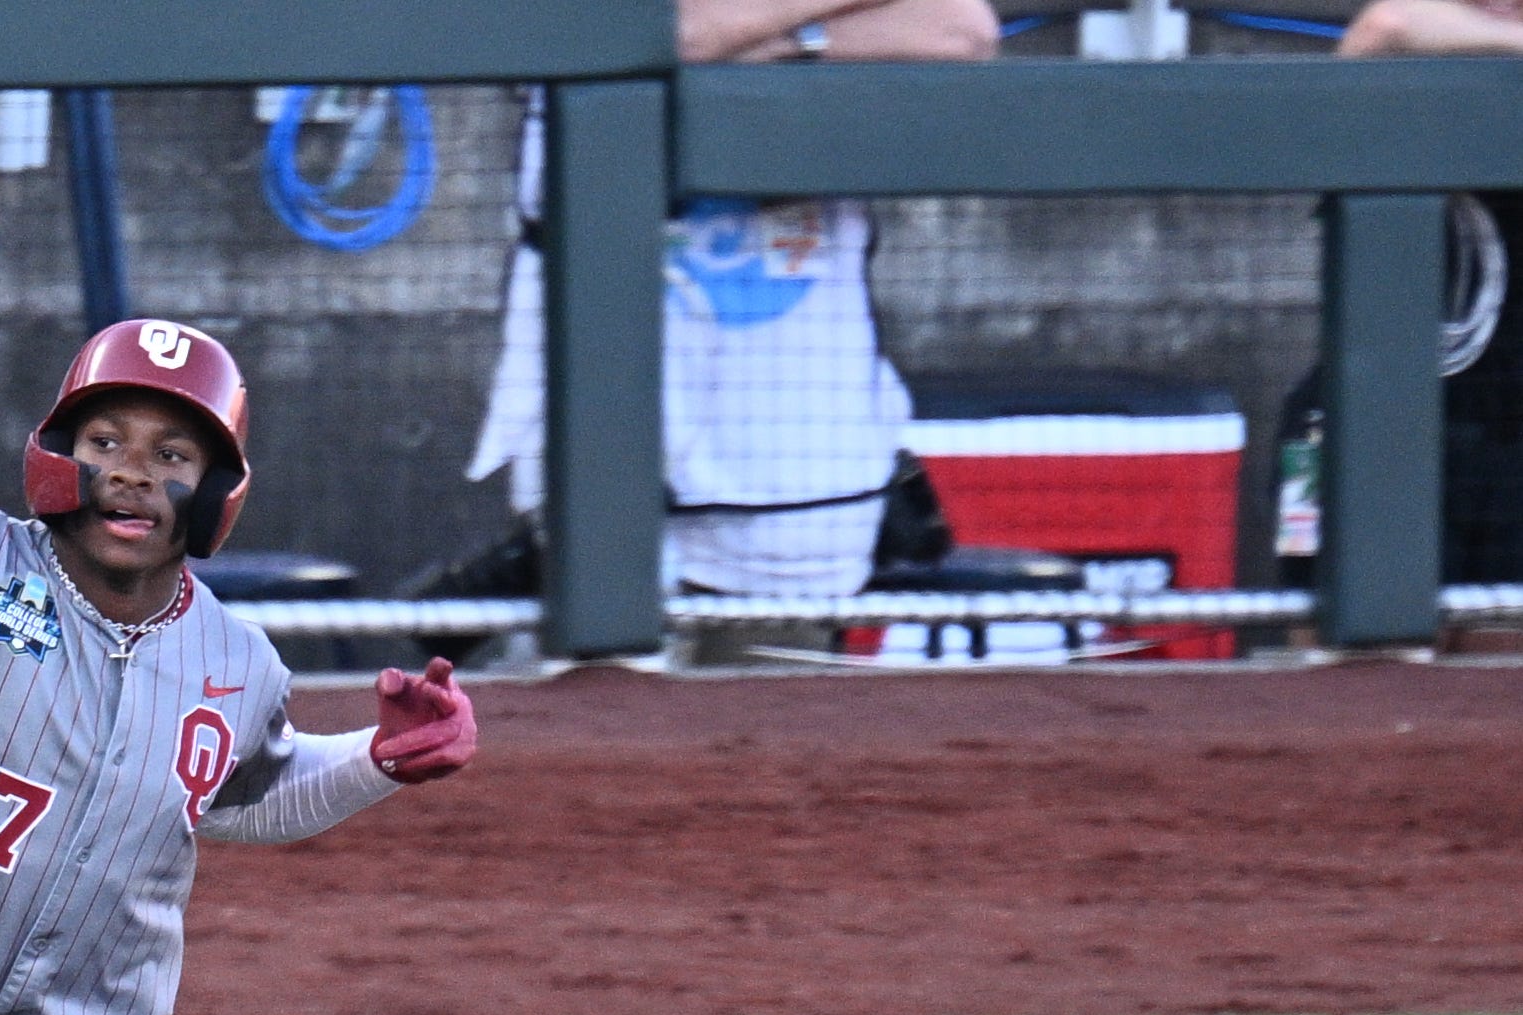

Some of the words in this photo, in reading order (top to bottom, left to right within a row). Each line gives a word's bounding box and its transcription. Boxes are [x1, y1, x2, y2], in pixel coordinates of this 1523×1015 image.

[138, 320, 191, 370] OU
[6, 603, 48, 631] COLLEGE
[22, 625, 58, 648] SERIES
